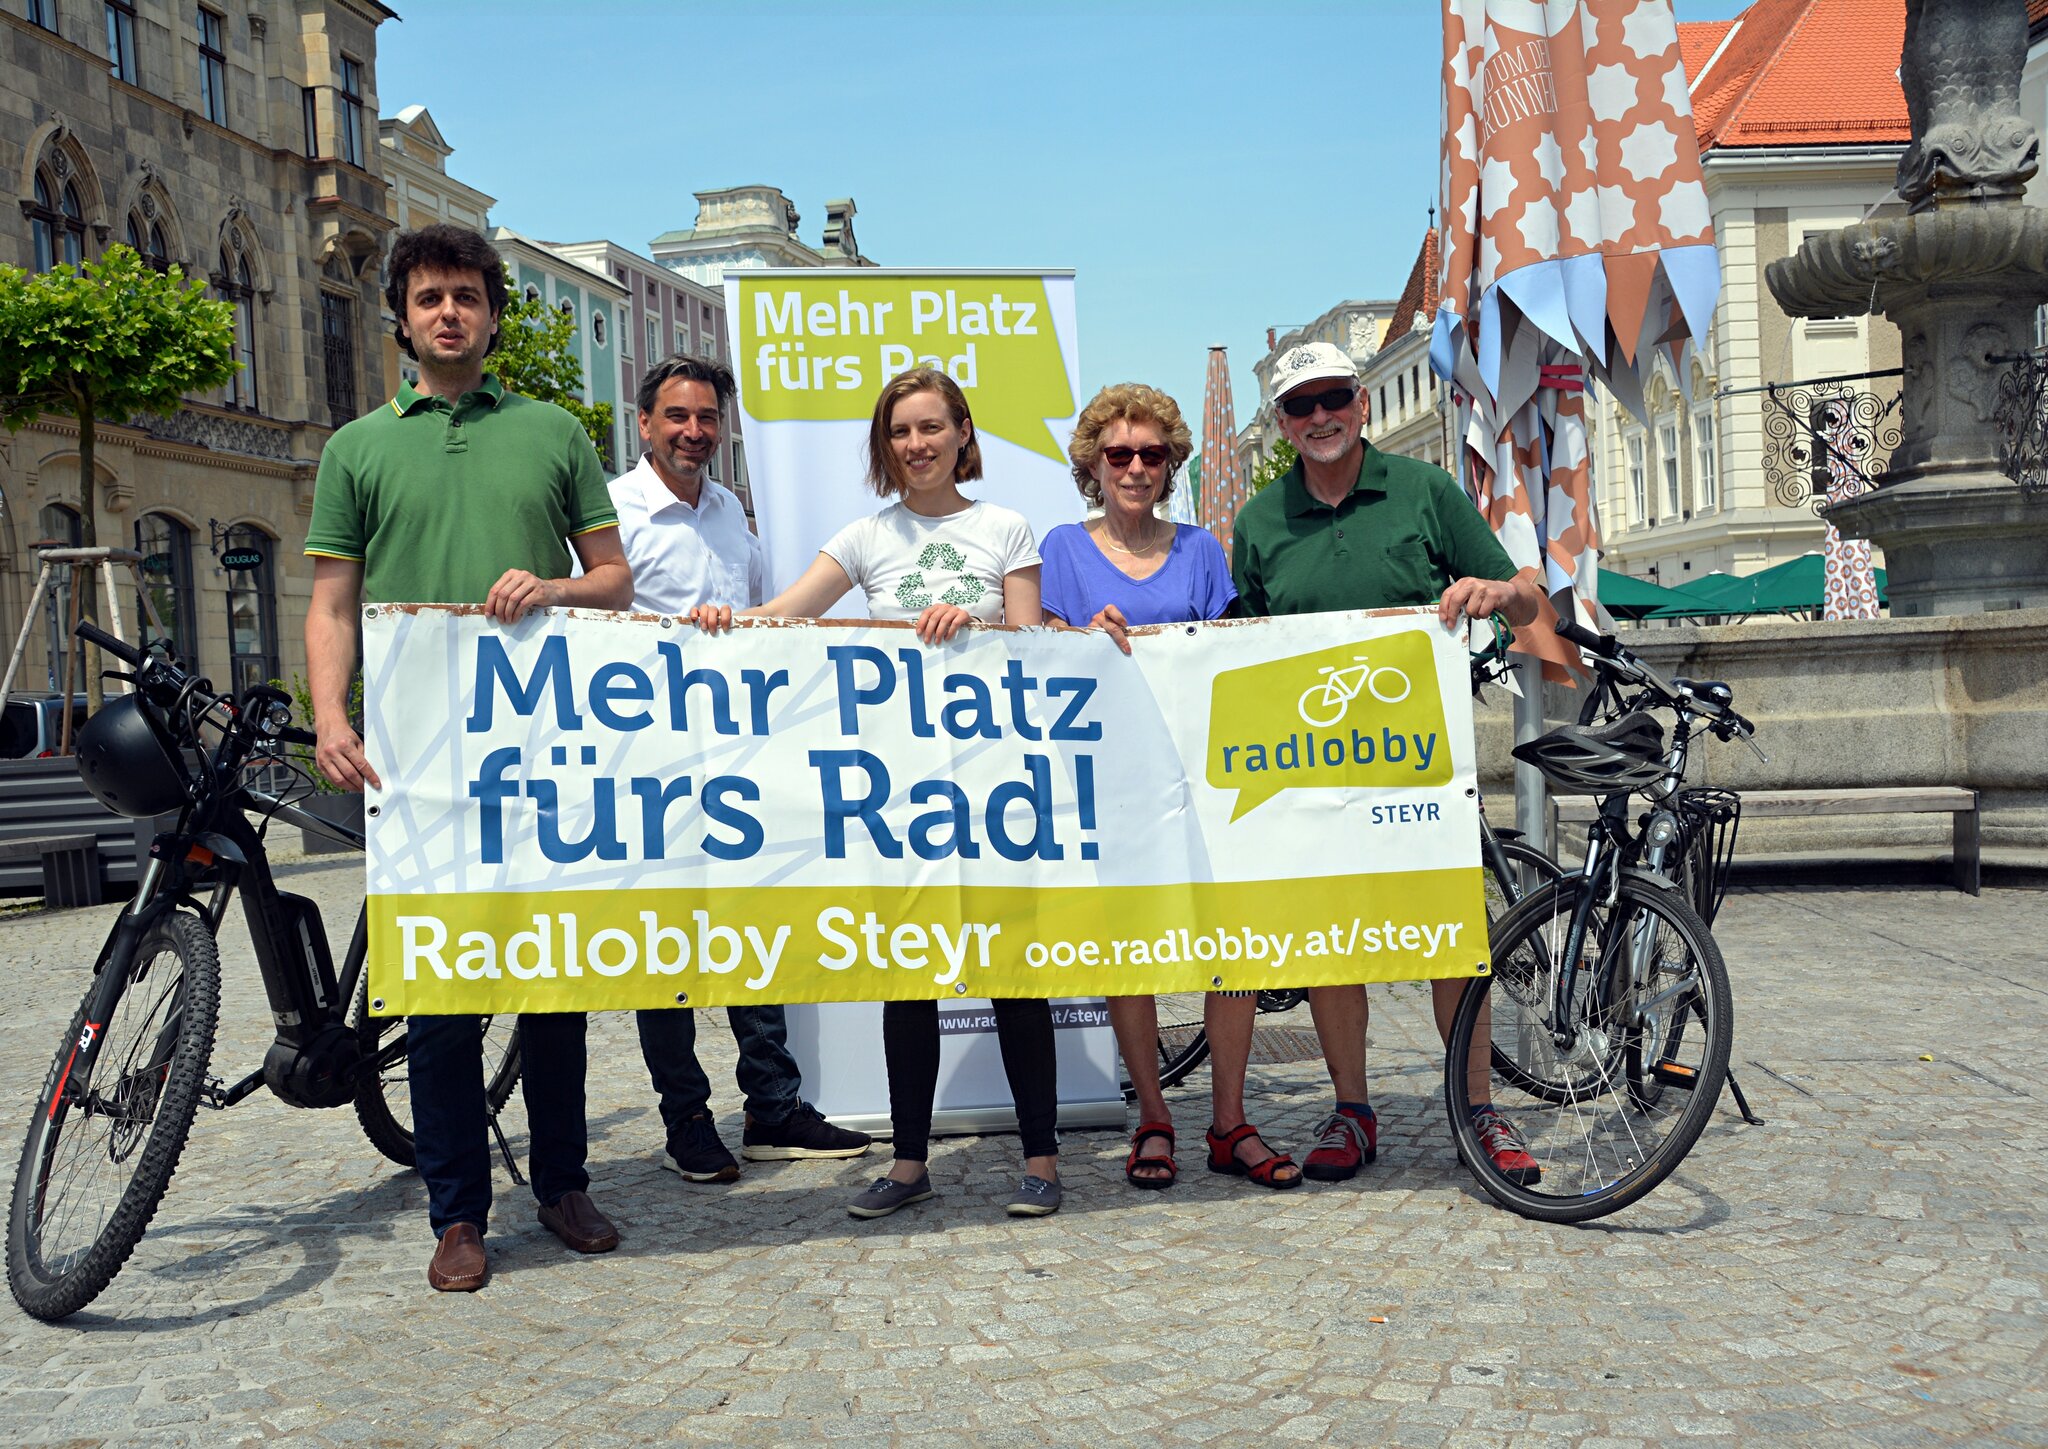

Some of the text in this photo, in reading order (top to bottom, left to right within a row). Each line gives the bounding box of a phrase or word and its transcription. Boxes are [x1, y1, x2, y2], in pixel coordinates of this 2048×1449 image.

[1492, 45, 1530, 82] UM
[1483, 71, 1559, 142] RUNNEN
[755, 289, 1038, 337] Mehr Platz
[756, 341, 863, 391] fürs
[466, 635, 1103, 742] Mehr Platz
[1223, 727, 1436, 771] radlobby
[469, 745, 1100, 864] fürs Rad!
[1371, 802, 1441, 825] STEYR
[396, 906, 1464, 991] Radlobby Steyr ooe.radlobby.at/steyr
